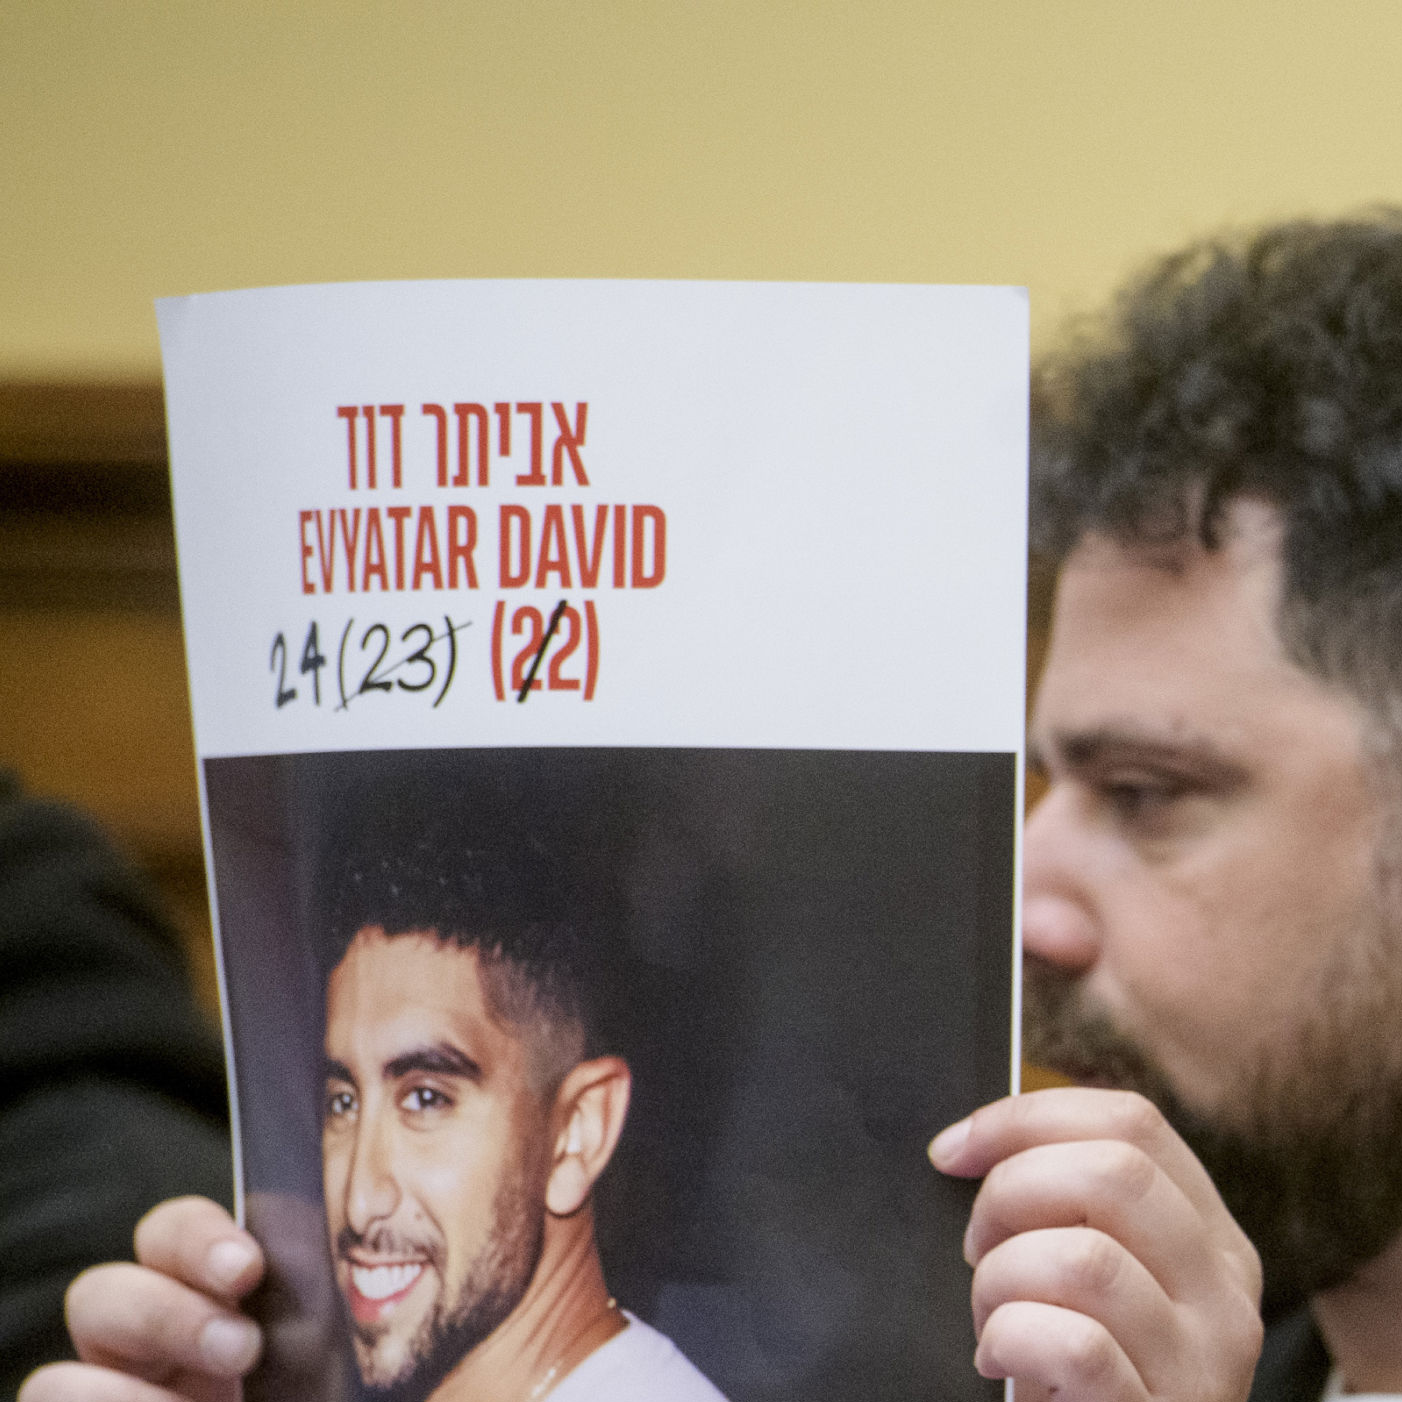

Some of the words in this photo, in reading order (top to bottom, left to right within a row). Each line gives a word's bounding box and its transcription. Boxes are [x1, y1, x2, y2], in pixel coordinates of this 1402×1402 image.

[336, 403, 405, 491] דוד
[421, 401, 590, 488] אביתר
[297, 505, 480, 596] EVYATAR
[498, 503, 668, 590] DAVID
[490, 599, 600, 702] (22)
